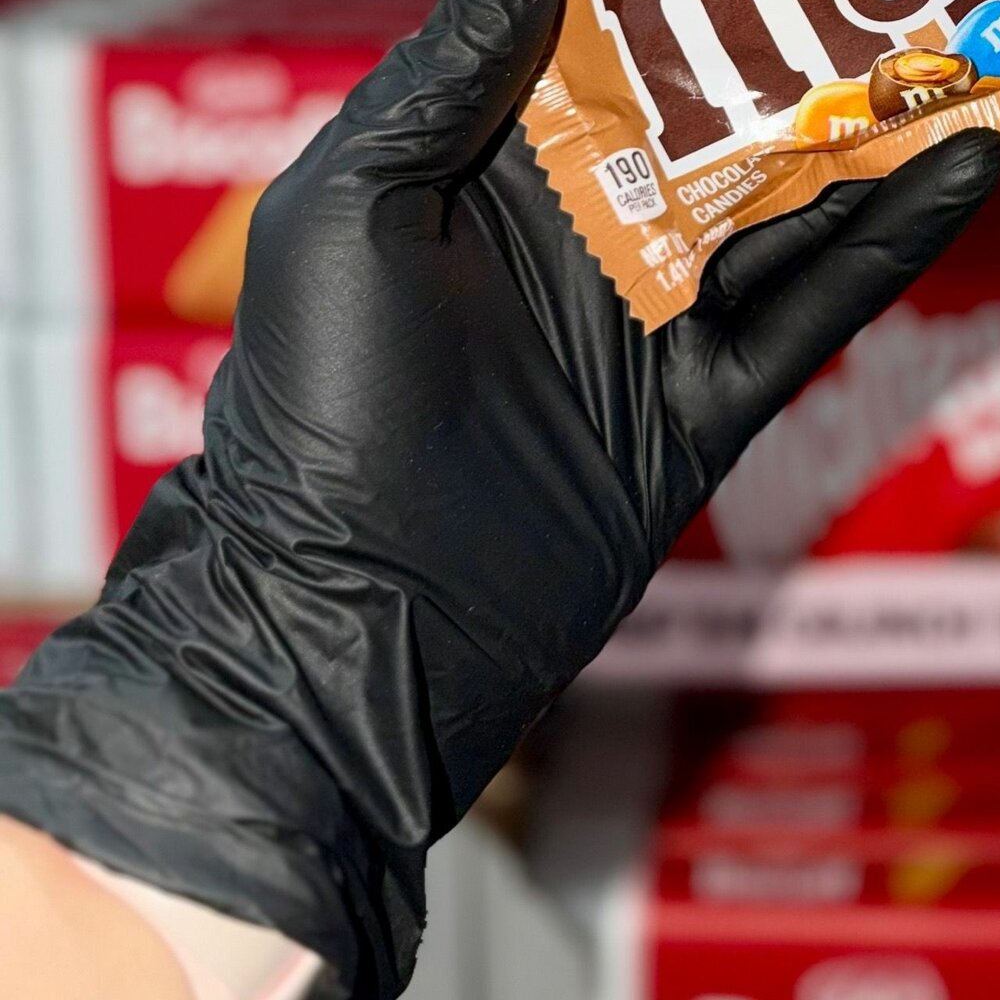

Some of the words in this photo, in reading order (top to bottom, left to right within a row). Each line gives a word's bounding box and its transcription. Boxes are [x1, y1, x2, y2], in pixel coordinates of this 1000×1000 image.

[605, 151, 651, 189] 190
[676, 145, 775, 206] CHOCOLA
[617, 183, 657, 207] CALORIES
[691, 169, 768, 224] CANDIES
